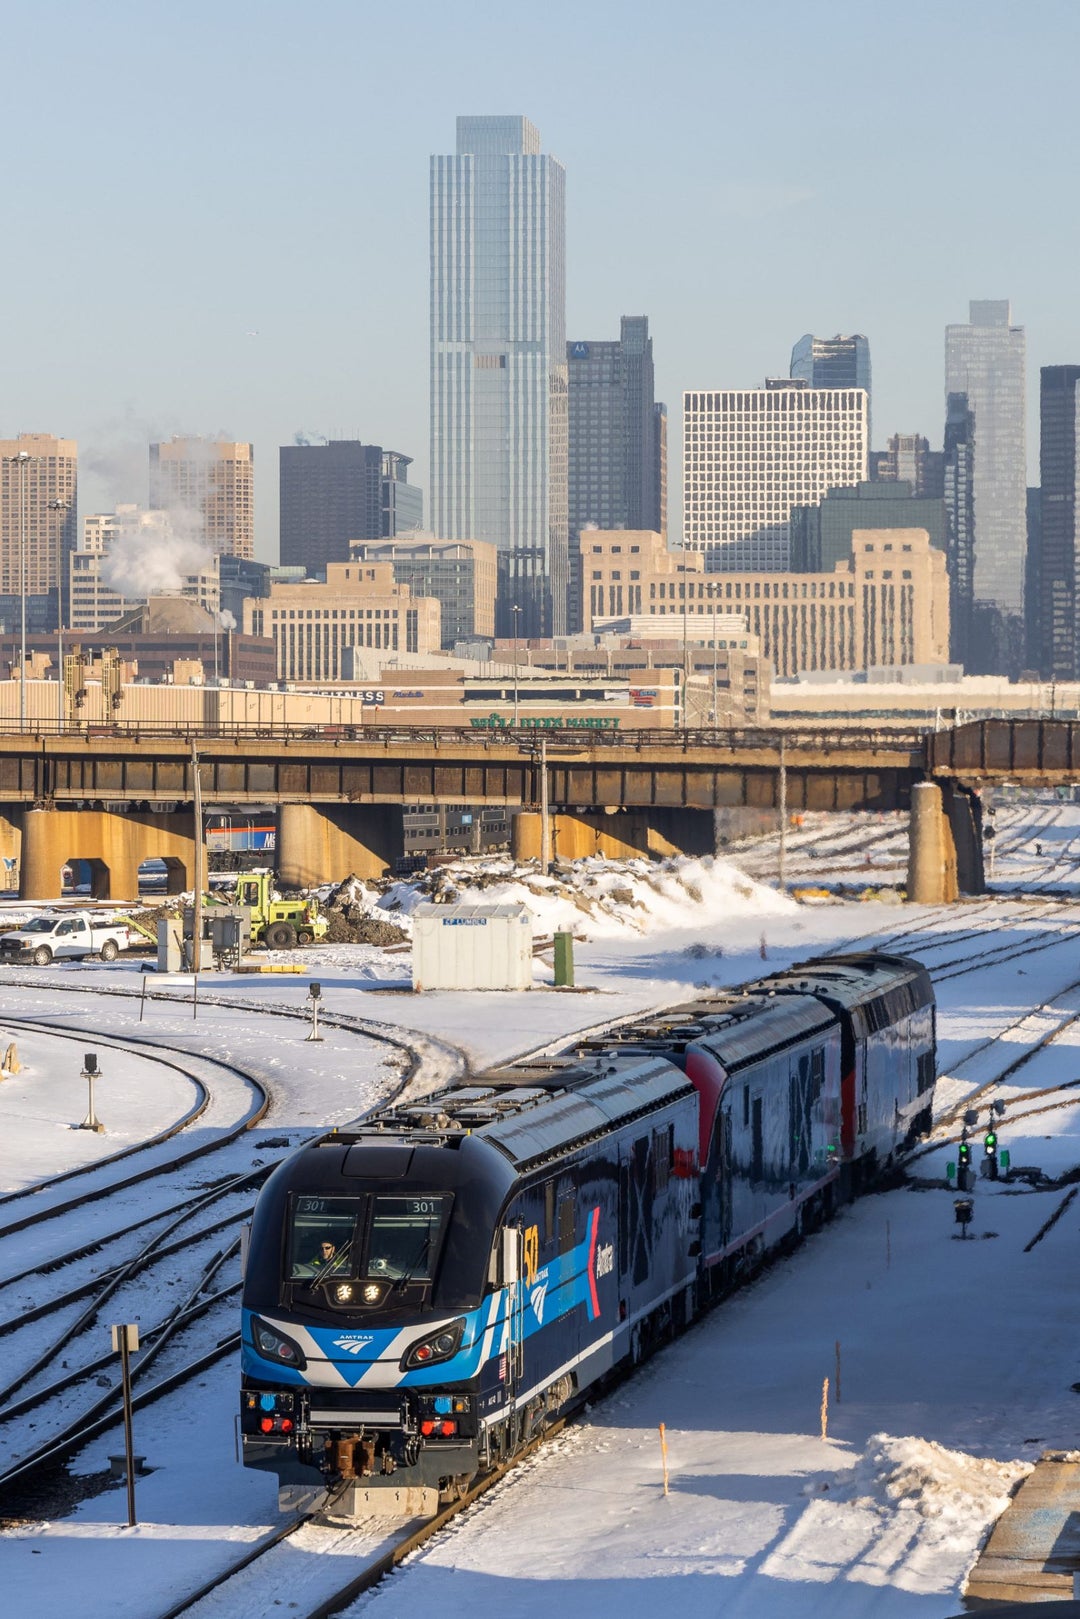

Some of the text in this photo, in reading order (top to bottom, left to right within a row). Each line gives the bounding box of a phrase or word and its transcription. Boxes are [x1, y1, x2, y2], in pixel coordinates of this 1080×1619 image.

[519, 717, 564, 728] FOODS
[566, 717, 621, 729] MARKET
[304, 1200, 325, 1211] 301
[413, 1201, 435, 1212] 301
